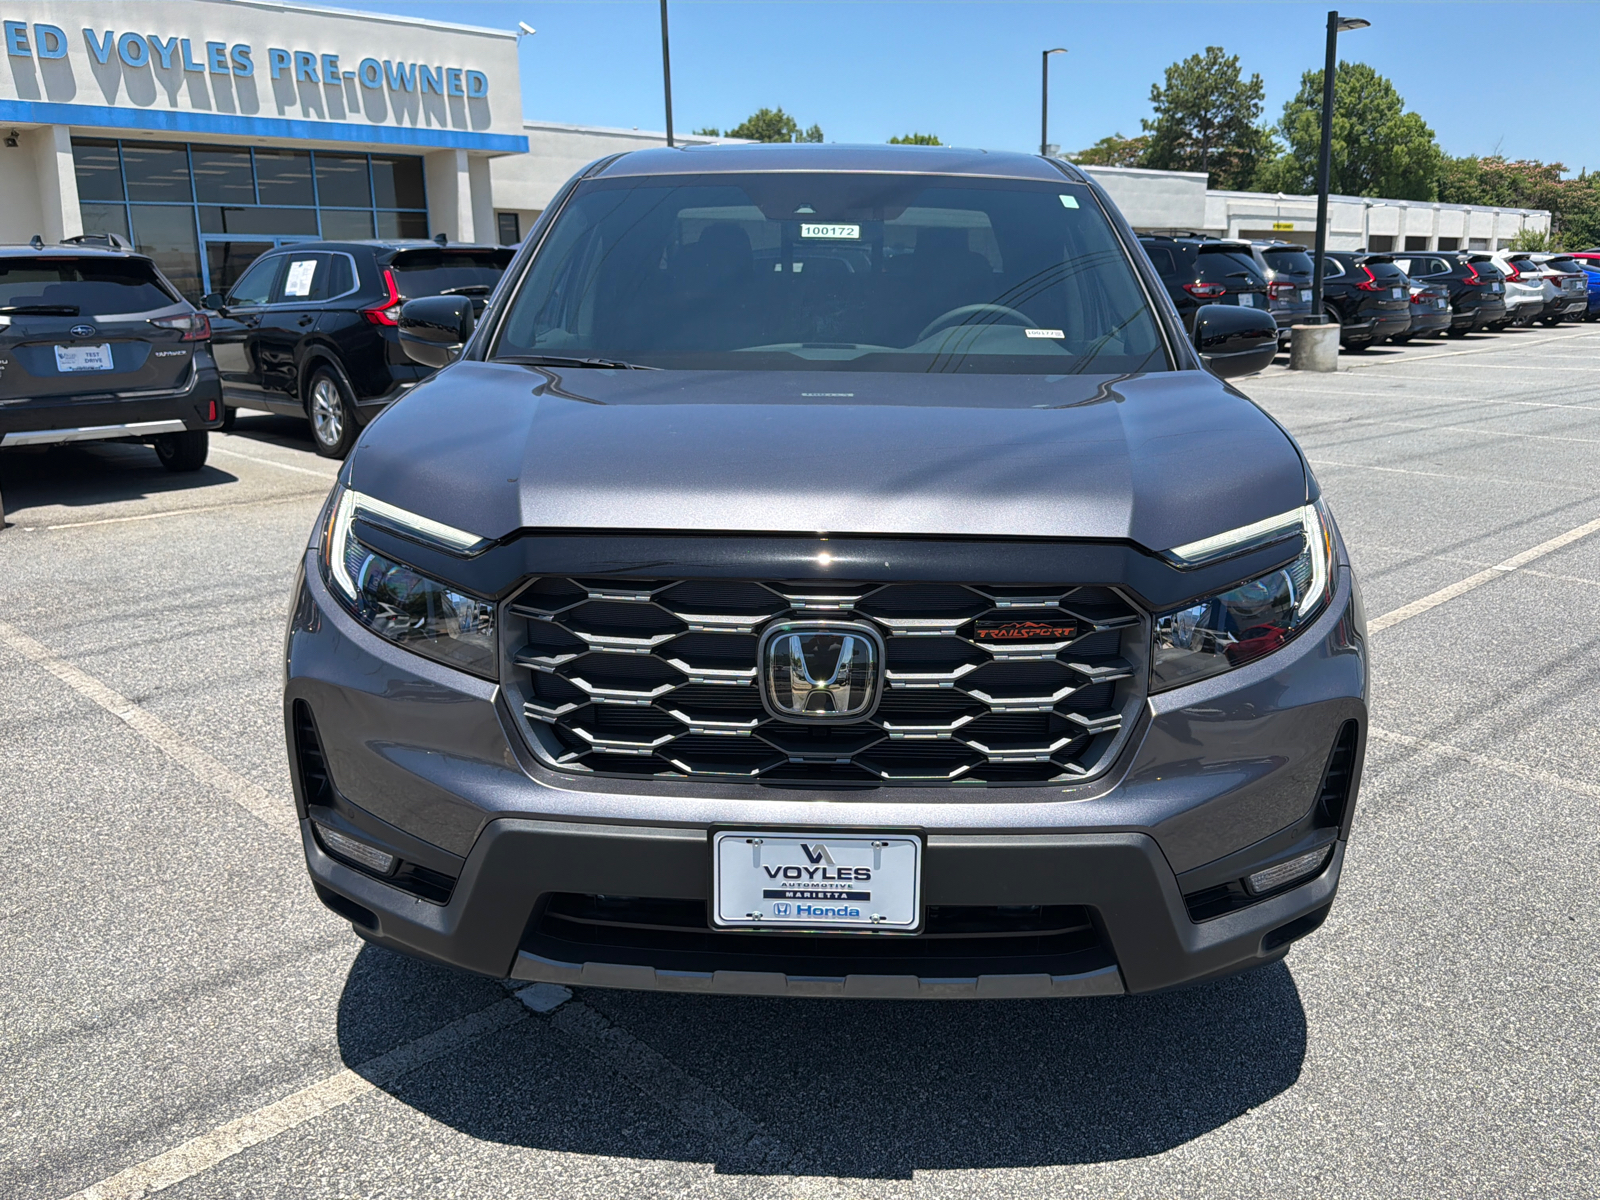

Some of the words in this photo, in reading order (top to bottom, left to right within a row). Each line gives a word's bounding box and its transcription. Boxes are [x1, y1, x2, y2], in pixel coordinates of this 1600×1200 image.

[4, 20, 68, 59] ED
[82, 28, 255, 77] VOYLES
[267, 48, 489, 98] PRE-OWNED
[804, 226, 855, 236] 100172
[977, 628, 1075, 639] TRAILSPORT
[763, 865, 872, 881] VOYLES
[785, 891, 848, 899] MARIETTA
[796, 904, 860, 917] Honda
